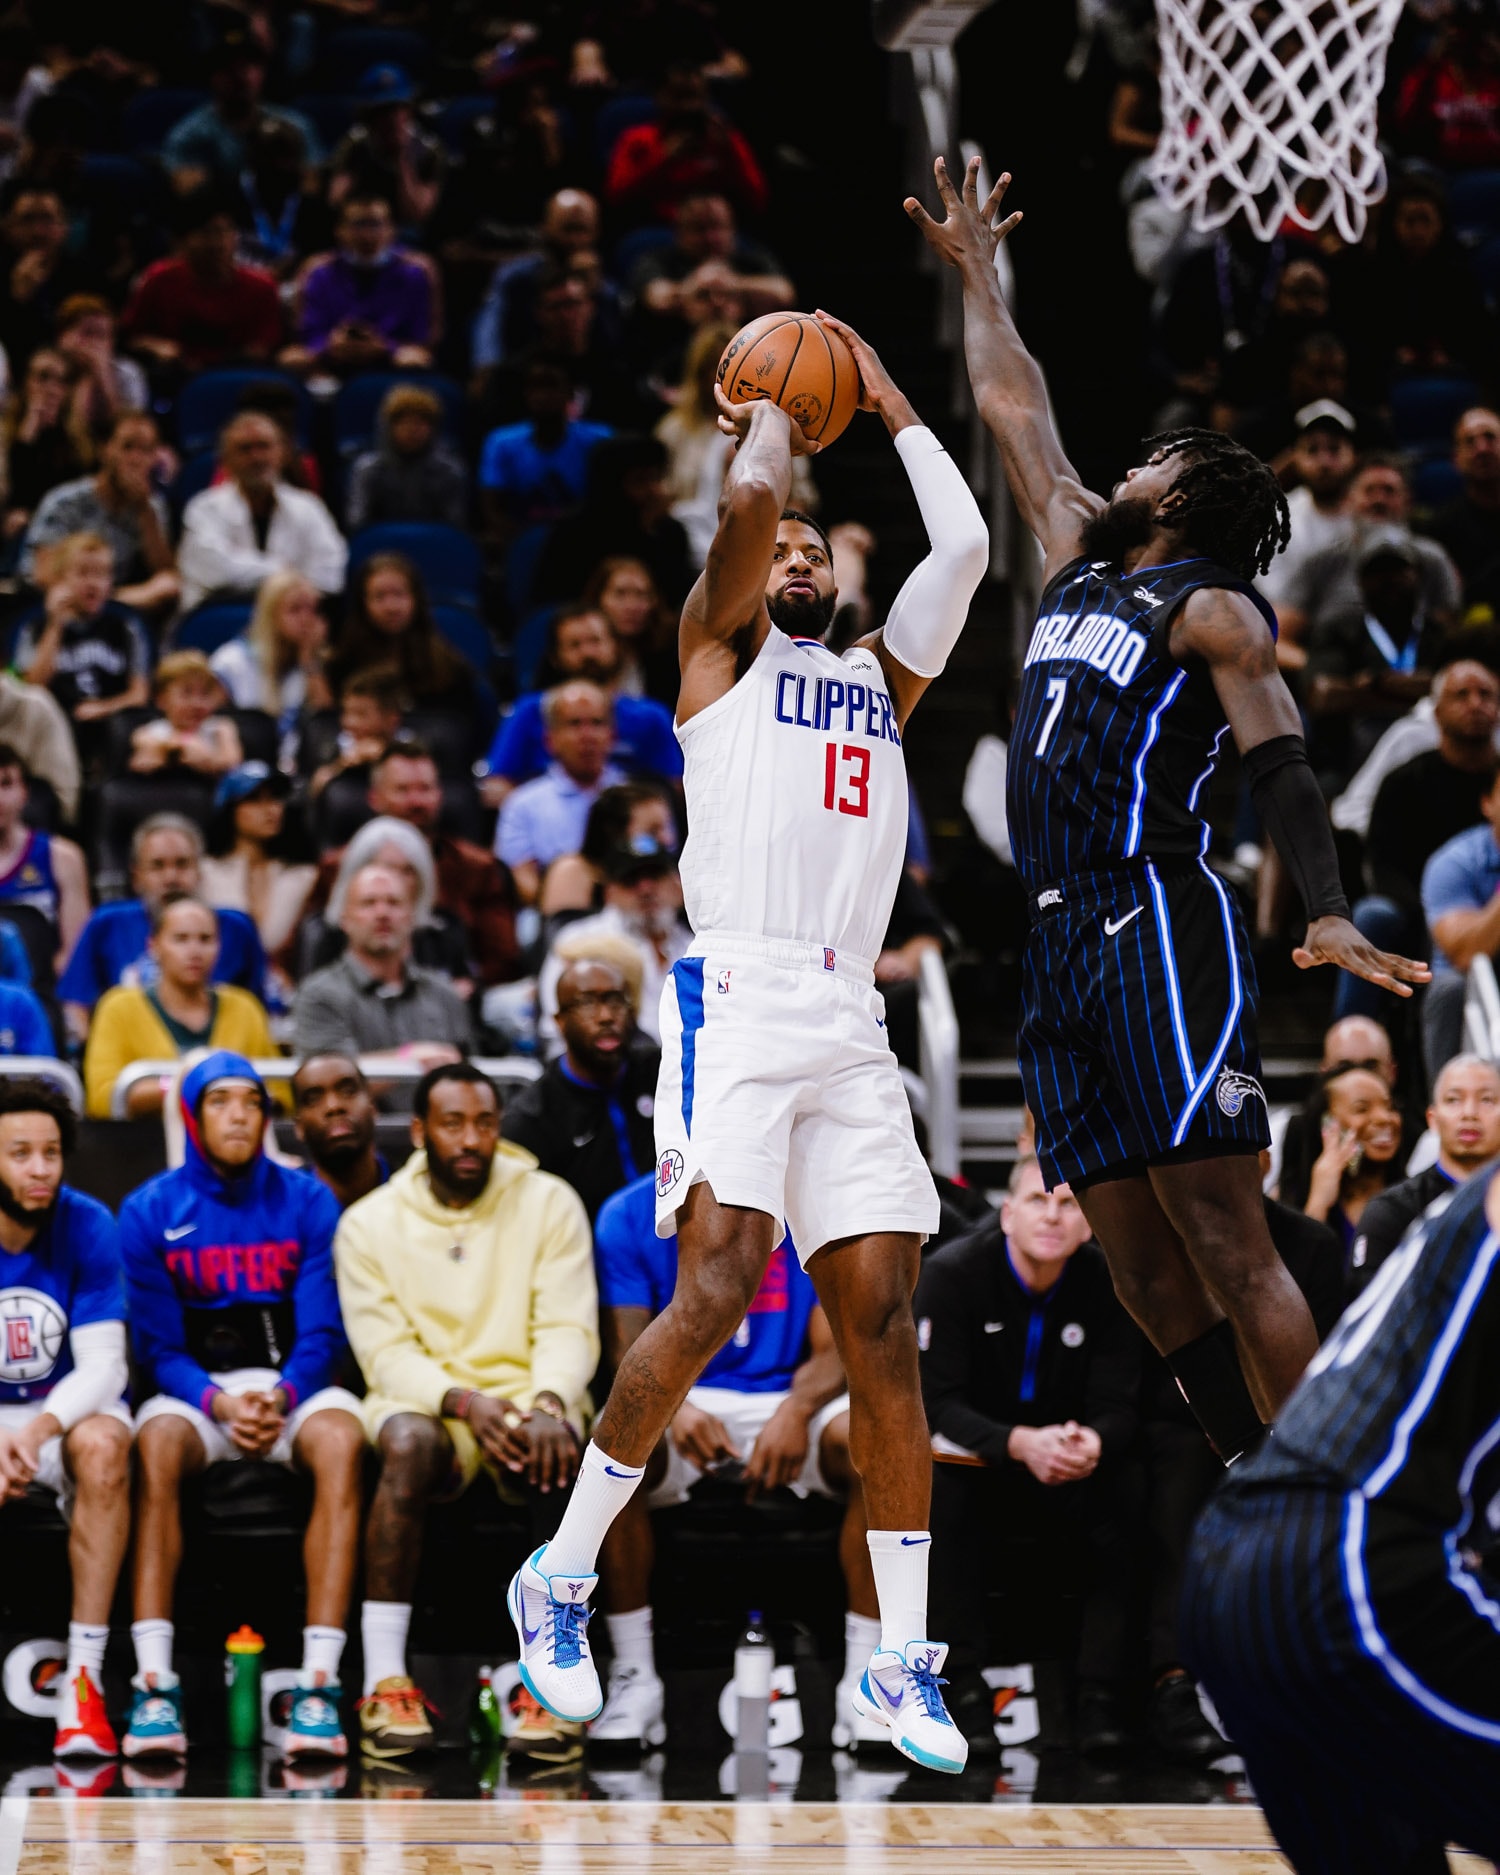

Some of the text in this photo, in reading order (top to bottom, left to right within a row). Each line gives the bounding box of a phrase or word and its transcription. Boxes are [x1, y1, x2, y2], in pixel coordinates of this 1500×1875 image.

[1024, 613, 1148, 690] ORLANDO
[1034, 677, 1068, 759] 7
[824, 742, 872, 819] 13
